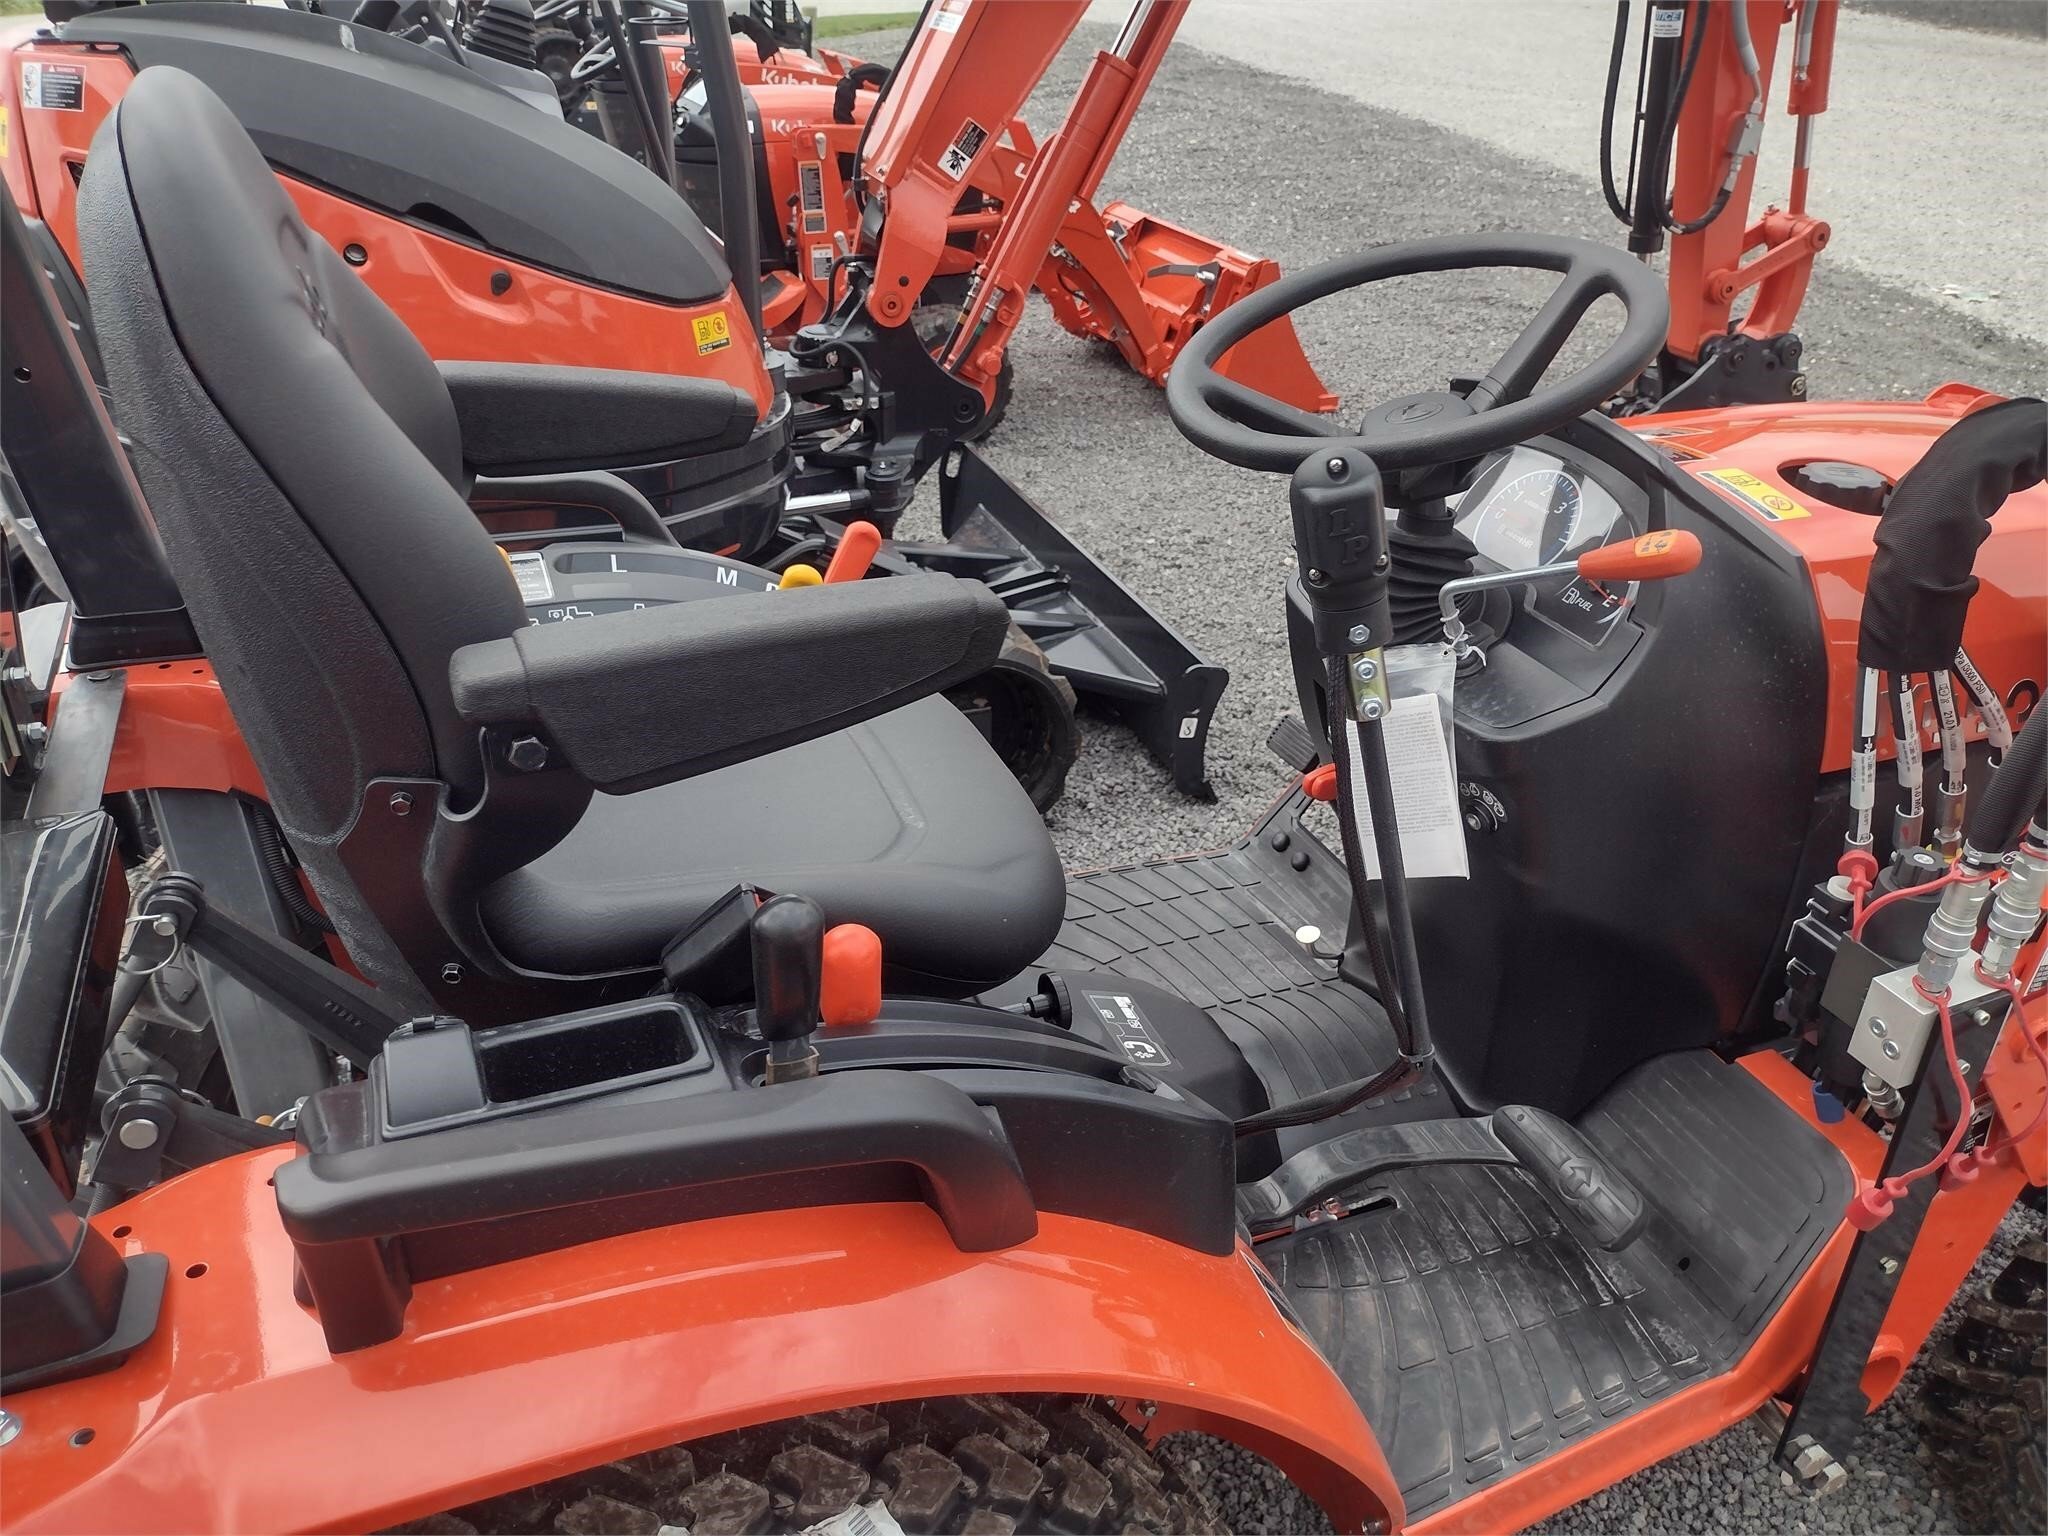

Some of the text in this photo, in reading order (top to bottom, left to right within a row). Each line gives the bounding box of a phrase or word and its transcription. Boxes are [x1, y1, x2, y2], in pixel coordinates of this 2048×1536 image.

[1513, 491, 1524, 502] 1
[1540, 485, 1553, 497] 2
[1554, 502, 1567, 514] 3
[610, 554, 627, 573] L
[716, 566, 738, 587] M
[1576, 597, 1593, 612] FUEL
[1602, 594, 1617, 608] E
